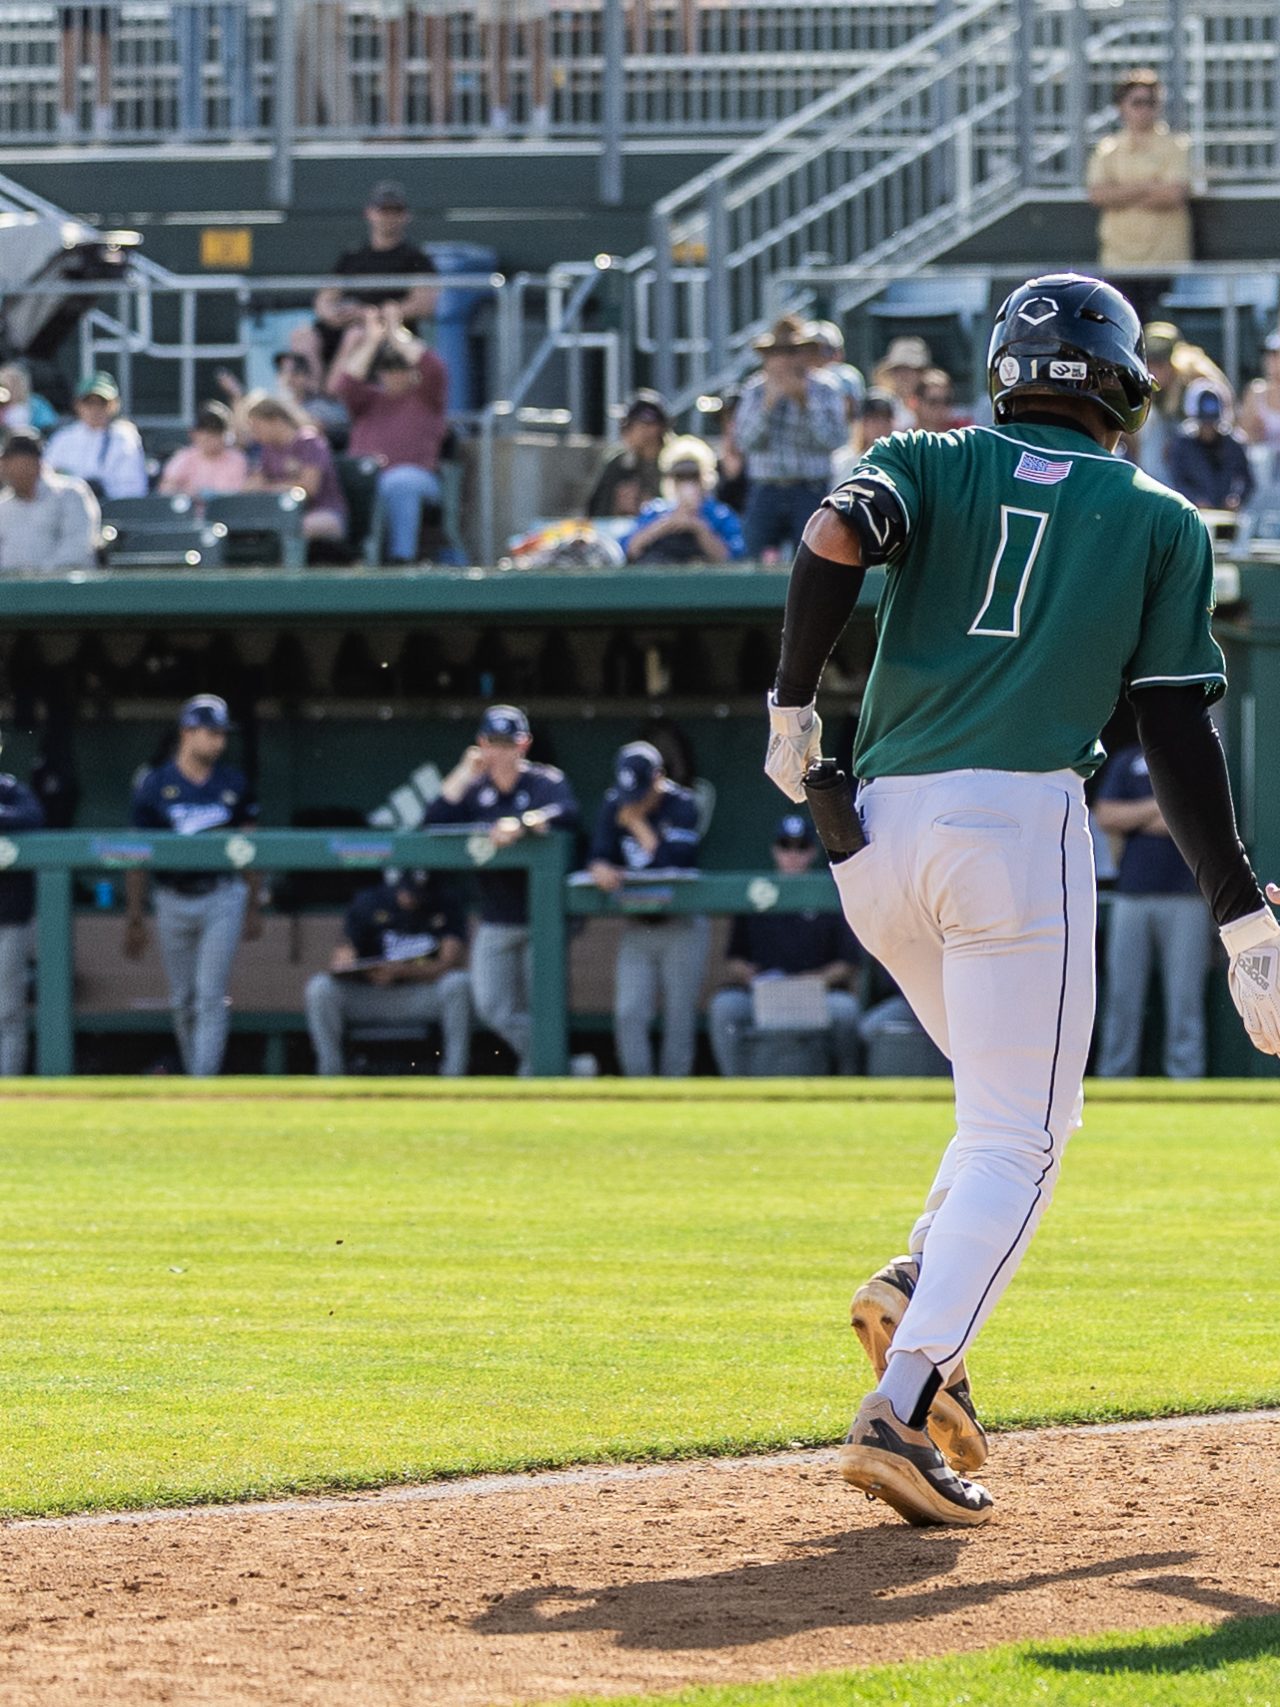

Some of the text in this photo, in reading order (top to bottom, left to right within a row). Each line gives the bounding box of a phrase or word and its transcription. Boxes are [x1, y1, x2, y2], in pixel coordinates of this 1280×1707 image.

[1030, 359, 1038, 380] 1
[967, 504, 1050, 638] 1
[1238, 957, 1270, 991] adidas
